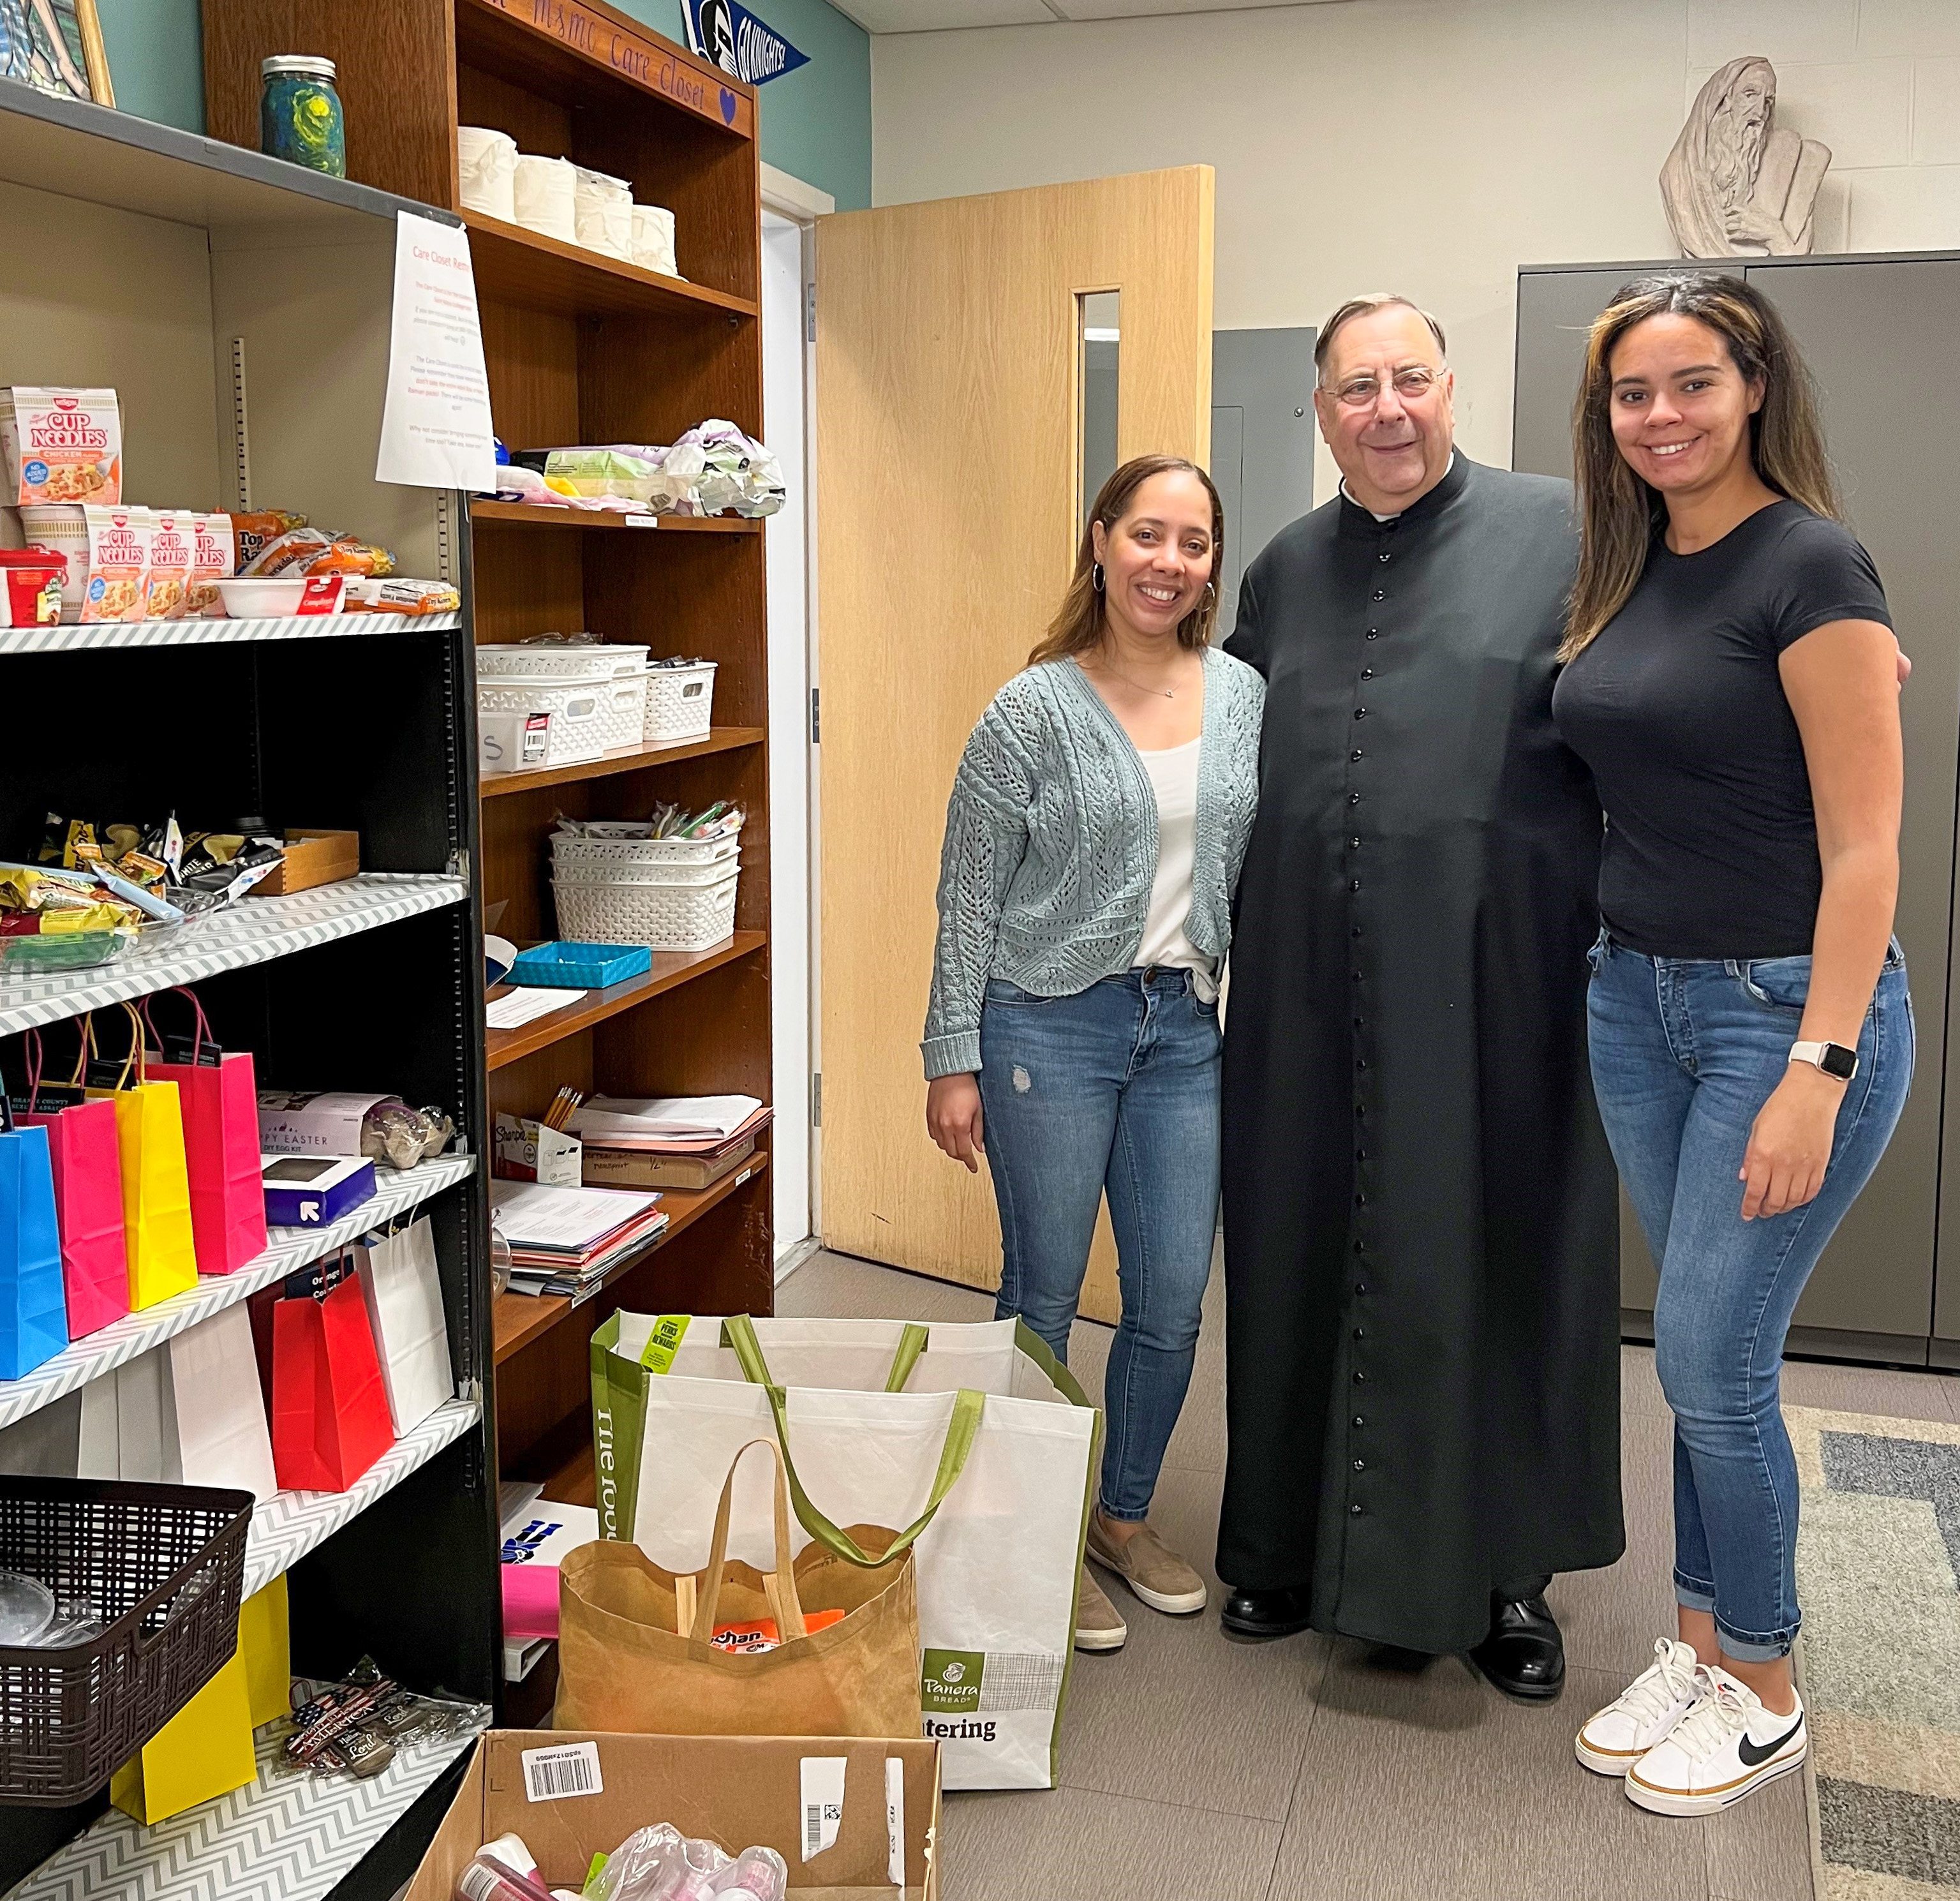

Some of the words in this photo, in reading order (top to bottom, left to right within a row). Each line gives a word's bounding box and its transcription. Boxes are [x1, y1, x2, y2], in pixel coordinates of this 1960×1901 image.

[611, 34, 650, 80] Care
[660, 57, 704, 110] Closet
[413, 246, 429, 261] Care
[48, 412, 91, 430] CUP
[31, 428, 107, 448] NOODLES
[108, 530, 135, 547] CUP
[158, 533, 181, 550] CUP
[195, 536, 214, 553] UP
[239, 531, 264, 549] Top
[98, 546, 144, 565] NOODLES
[195, 550, 225, 567] DLES
[241, 547, 262, 562] Ra
[484, 736, 503, 761] S
[285, 1135, 327, 1145] EASTER
[312, 1269, 340, 1285] Ornge
[711, 1631, 761, 1645] chan
[924, 1678, 978, 1696] Panera
[933, 1695, 967, 1703] BREAD
[383, 1705, 409, 1725] Lord
[303, 1706, 375, 1750] AMERICA
[922, 1718, 997, 1742] tering
[349, 1733, 376, 1760] Lord
